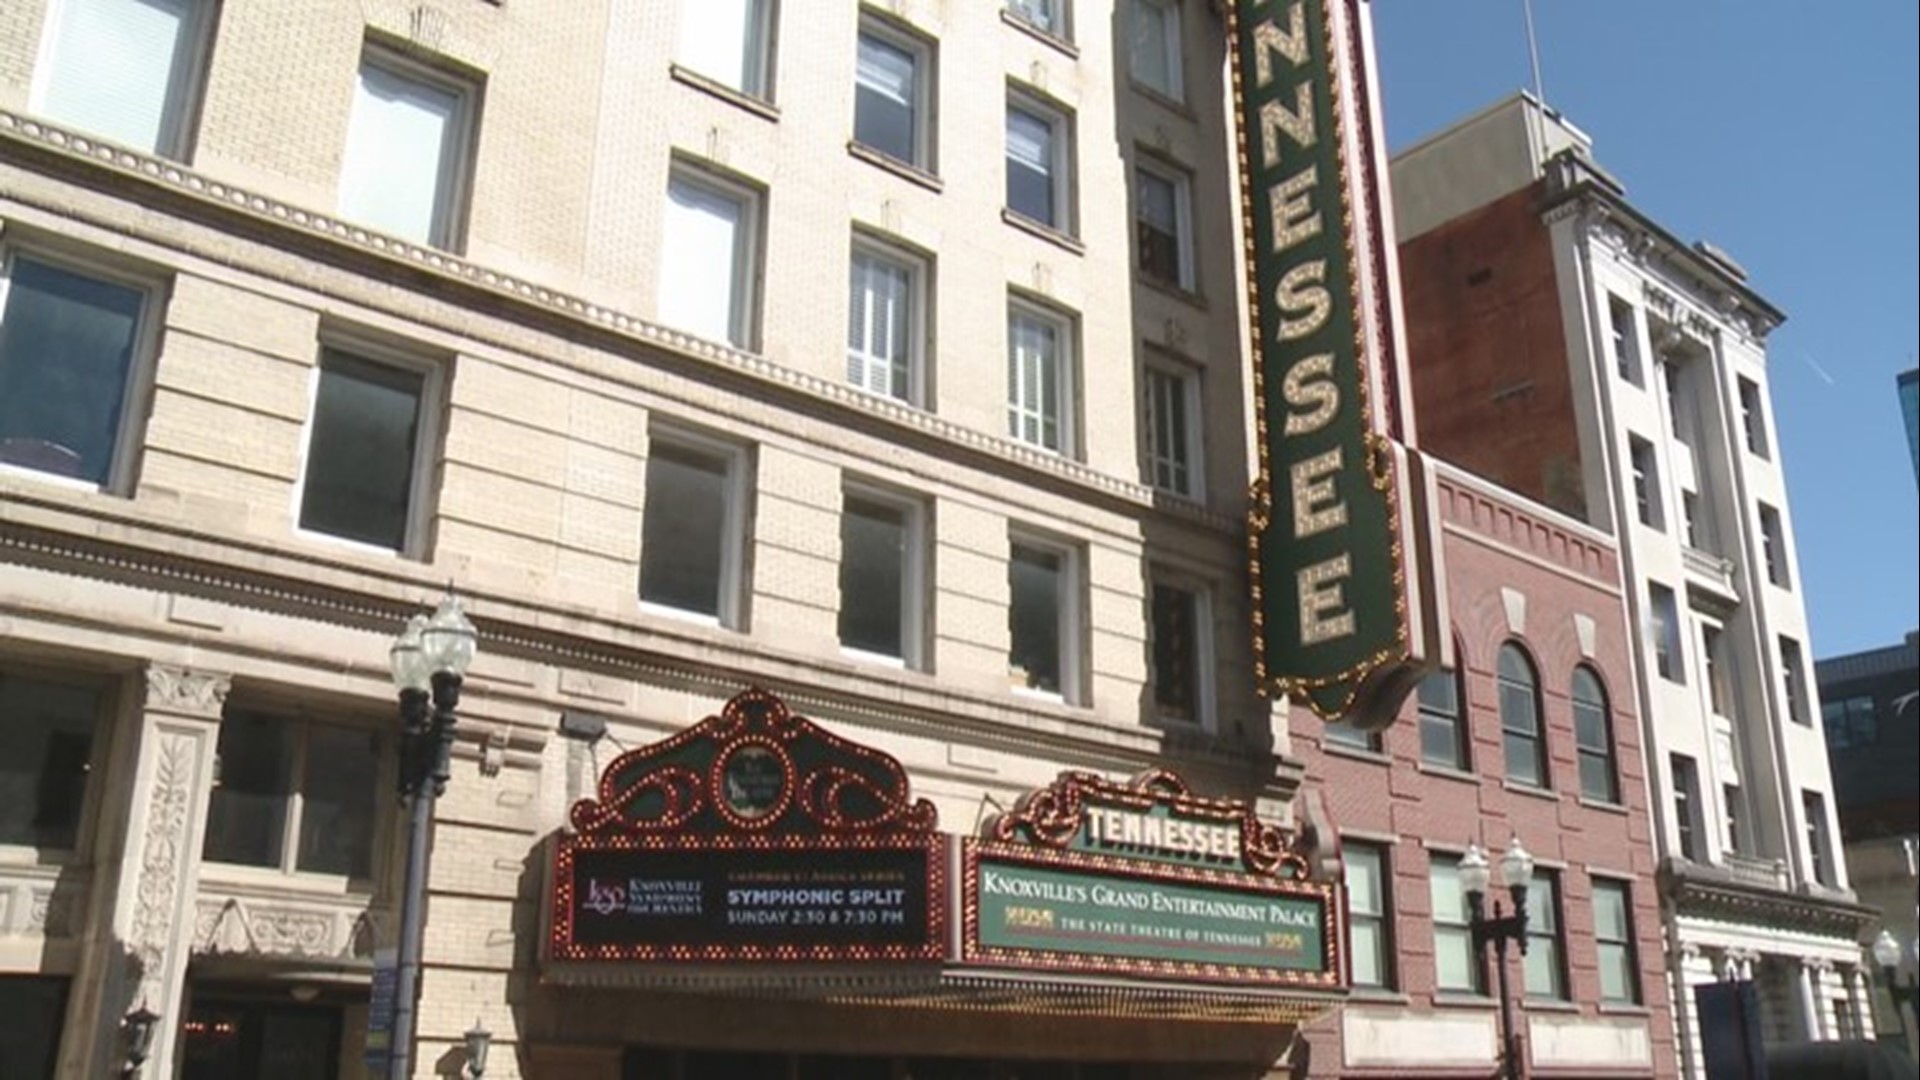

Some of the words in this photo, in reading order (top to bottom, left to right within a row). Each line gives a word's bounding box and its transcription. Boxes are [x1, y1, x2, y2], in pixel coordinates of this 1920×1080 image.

[1253, 0, 1356, 645] NNESSEE
[1087, 806, 1240, 859] TENNESSEE
[727, 889, 844, 905] SYMPHONIC
[849, 889, 905, 904] SPLIT
[984, 871, 1088, 903] KNOXVILLE'S
[1091, 885, 1149, 910] GRAND
[1152, 891, 1267, 922] ENTERTAINMENT
[1269, 904, 1317, 927] PALACE
[727, 910, 788, 925] SUNDAY
[792, 910, 825, 924] 2:30
[844, 910, 877, 924] 7:30
[881, 909, 904, 924] PM
[1061, 917, 1085, 931] THE
[1089, 920, 1125, 934] STATE
[1131, 924, 1181, 940] THEATRE
[1184, 929, 1200, 941] OF
